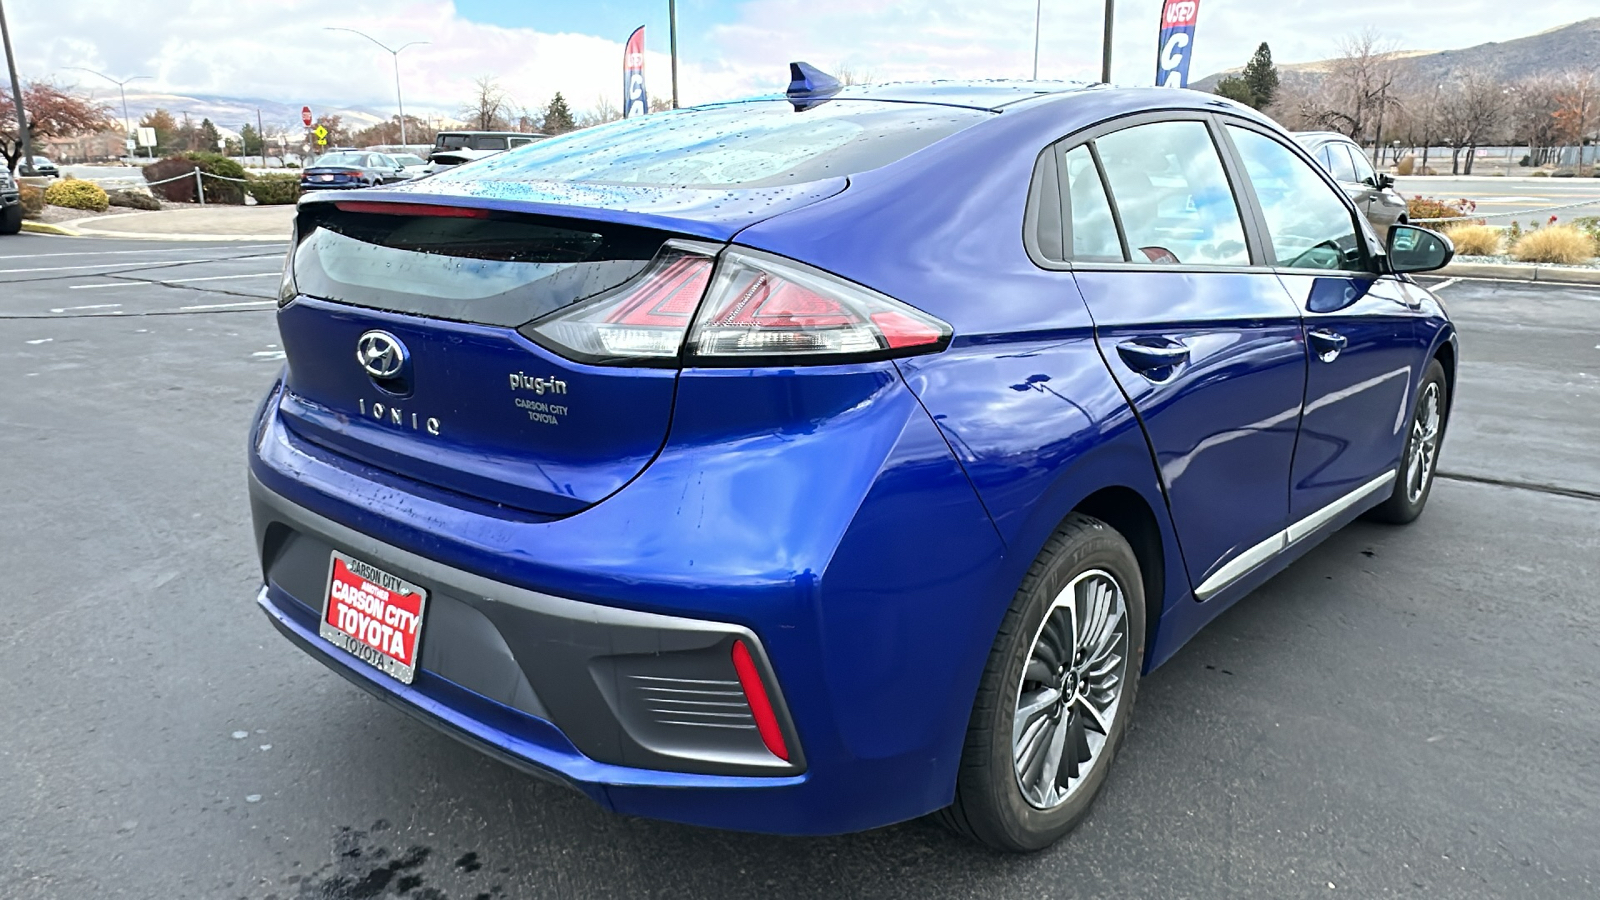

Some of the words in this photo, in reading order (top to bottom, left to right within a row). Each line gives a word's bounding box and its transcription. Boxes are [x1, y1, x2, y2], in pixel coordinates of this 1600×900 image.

[1166, 1, 1196, 23] USED
[509, 371, 567, 395] plug-in
[359, 398, 441, 436] IONIQ
[515, 398, 549, 412] CARSON
[549, 404, 568, 416] CITY
[528, 411, 559, 425] TOYOTA
[351, 559, 381, 584] CARSON
[382, 574, 402, 593] CITY
[361, 581, 389, 601] ANOTHER
[332, 579, 385, 620] CARSON
[384, 604, 420, 635] CITY
[337, 602, 406, 659] TOYOTA
[344, 634, 385, 669] TOYOTA
